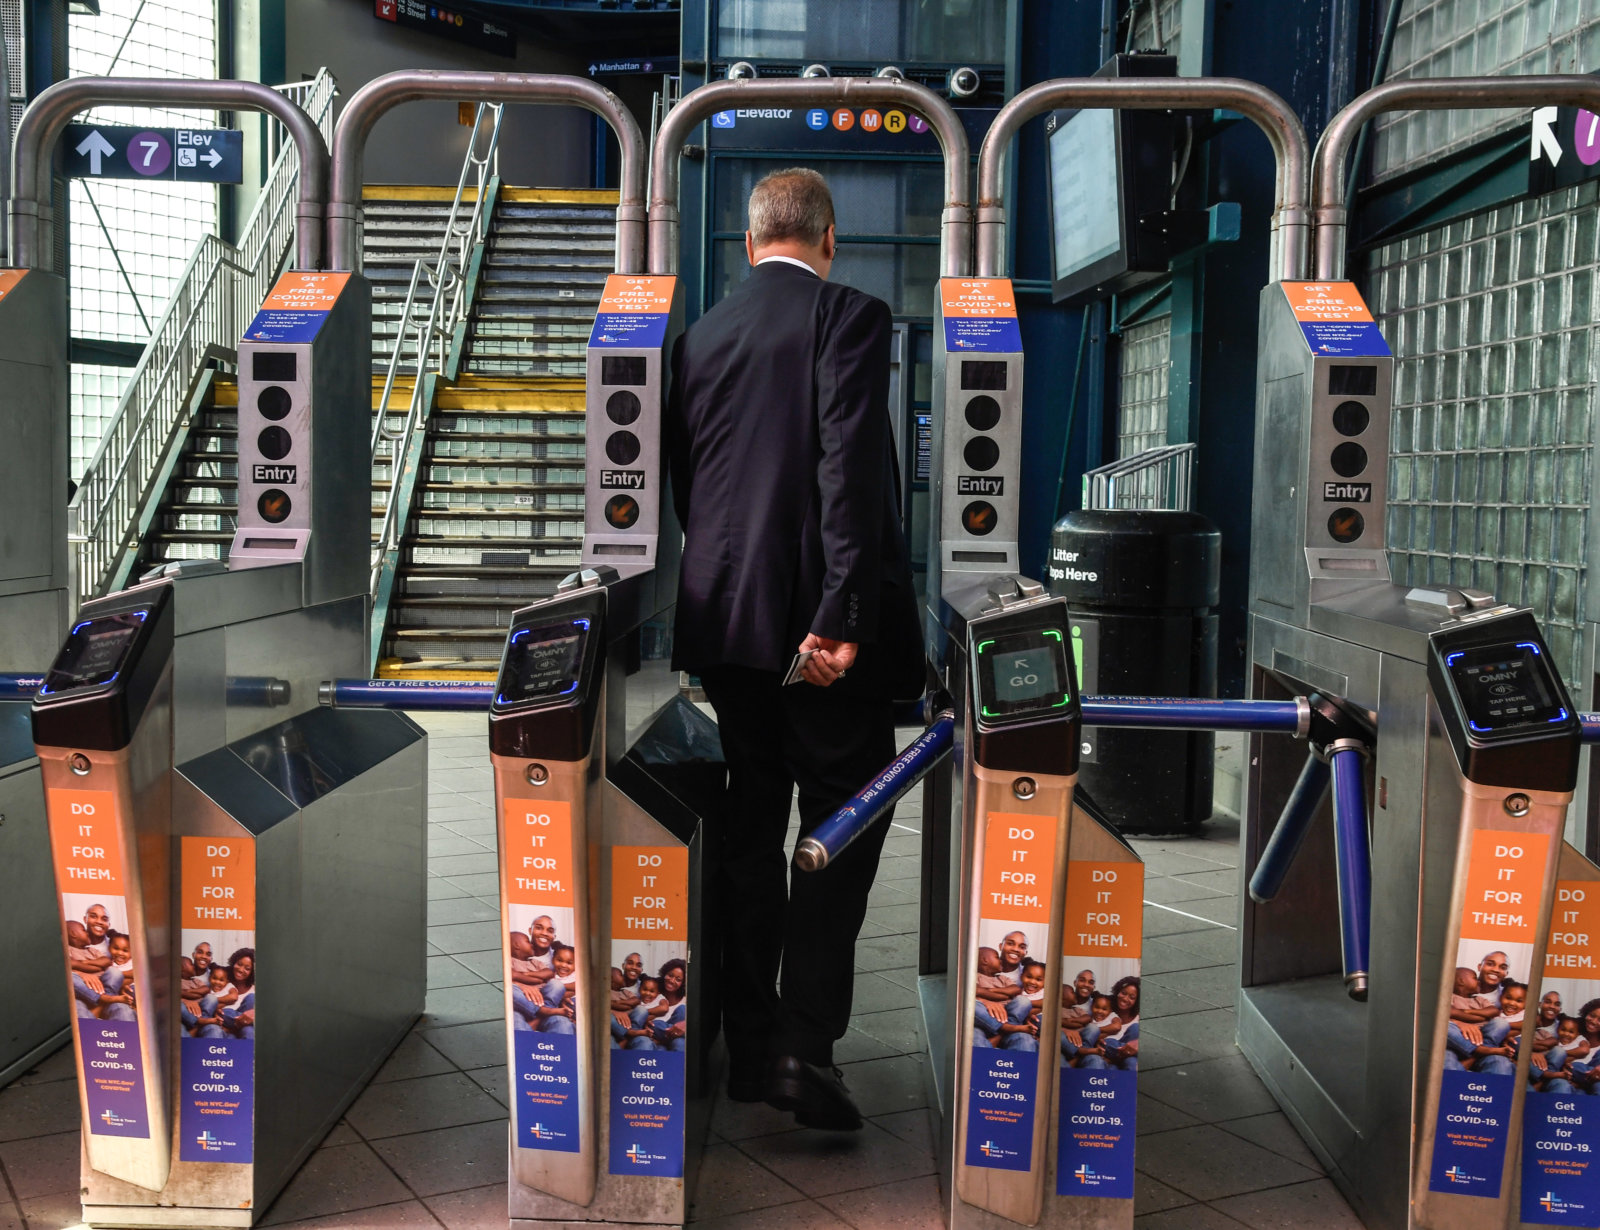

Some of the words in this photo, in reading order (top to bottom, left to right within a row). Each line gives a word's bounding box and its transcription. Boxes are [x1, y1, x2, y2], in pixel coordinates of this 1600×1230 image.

[408, 8, 426, 20] Street
[736, 109, 792, 118] Elevator
[812, 113, 822, 125] E
[838, 113, 848, 126] F
[864, 114, 877, 126] M
[890, 115, 900, 127] R
[178, 131, 212, 145] Elev
[140, 141, 159, 166] 7
[255, 466, 295, 483] Entry
[602, 471, 644, 488] Entry
[960, 477, 1002, 495] Entry
[1325, 484, 1369, 501] Entry
[1053, 548, 1079, 562] Litter
[1066, 568, 1098, 582] Here
[533, 646, 566, 658] OMNY
[1010, 674, 1038, 686] GO
[1479, 671, 1518, 683] OMNY
[922, 732, 936, 742] Get
[902, 747, 921, 764] FREE
[874, 762, 905, 790] COVID-19
[861, 789, 878, 802] Test
[71, 803, 95, 815] DO
[526, 814, 550, 826] DO
[79, 825, 92, 836] IT
[1008, 828, 1035, 840] DO
[532, 836, 546, 847] IT
[72, 846, 104, 858] FOR
[207, 846, 230, 858] DO
[1012, 850, 1028, 862] IT
[1495, 846, 1524, 859] DO
[523, 856, 556, 870] FOR
[638, 855, 662, 867] DO
[66, 867, 115, 880] THEM.
[212, 866, 225, 878] IT
[1000, 871, 1036, 885] FOR
[1092, 870, 1117, 883] DO
[1498, 869, 1515, 880] IT
[515, 878, 566, 892] THEM.
[642, 876, 657, 887] IT
[202, 886, 234, 898] FOR
[1097, 892, 1112, 904] IT
[1484, 890, 1522, 904] FOR
[1559, 889, 1585, 902] DO
[633, 896, 666, 909] FOR
[991, 892, 1043, 908] THEM.
[194, 907, 242, 920] THEM.
[1086, 913, 1120, 926] FOR
[1472, 912, 1528, 927] THEM.
[1564, 911, 1579, 924] IT
[625, 917, 673, 930] THEM.
[1077, 933, 1128, 947] THEM.
[1552, 933, 1589, 946] FOR
[1546, 954, 1597, 968] THEM.
[209, 1046, 226, 1054] Get
[202, 1059, 233, 1067] tested
[532, 1053, 560, 1062] tested
[639, 1058, 657, 1066] Get
[91, 1061, 135, 1070] COVID-19.
[996, 1060, 1014, 1068] Get
[210, 1071, 224, 1079] for
[524, 1074, 570, 1084] COVID-19.
[632, 1071, 663, 1080] tested
[989, 1070, 1020, 1079] tested
[1089, 1077, 1108, 1086] Get
[1468, 1083, 1487, 1092] Get
[193, 1084, 242, 1093] COVID-19.
[640, 1084, 655, 1092] for
[978, 1090, 1027, 1101] COVID-19.
[1082, 1090, 1115, 1099] tested
[1459, 1094, 1493, 1103] tested
[622, 1096, 672, 1106] COVID-19.
[1090, 1103, 1106, 1111] for
[1555, 1102, 1575, 1111] Get
[1466, 1105, 1482, 1113] for
[1071, 1115, 1124, 1126] COVID-19.
[1446, 1115, 1499, 1126] COVID-19.
[1547, 1115, 1582, 1125] tested
[1556, 1129, 1572, 1138] for
[1536, 1141, 1592, 1153] COVID-19.
